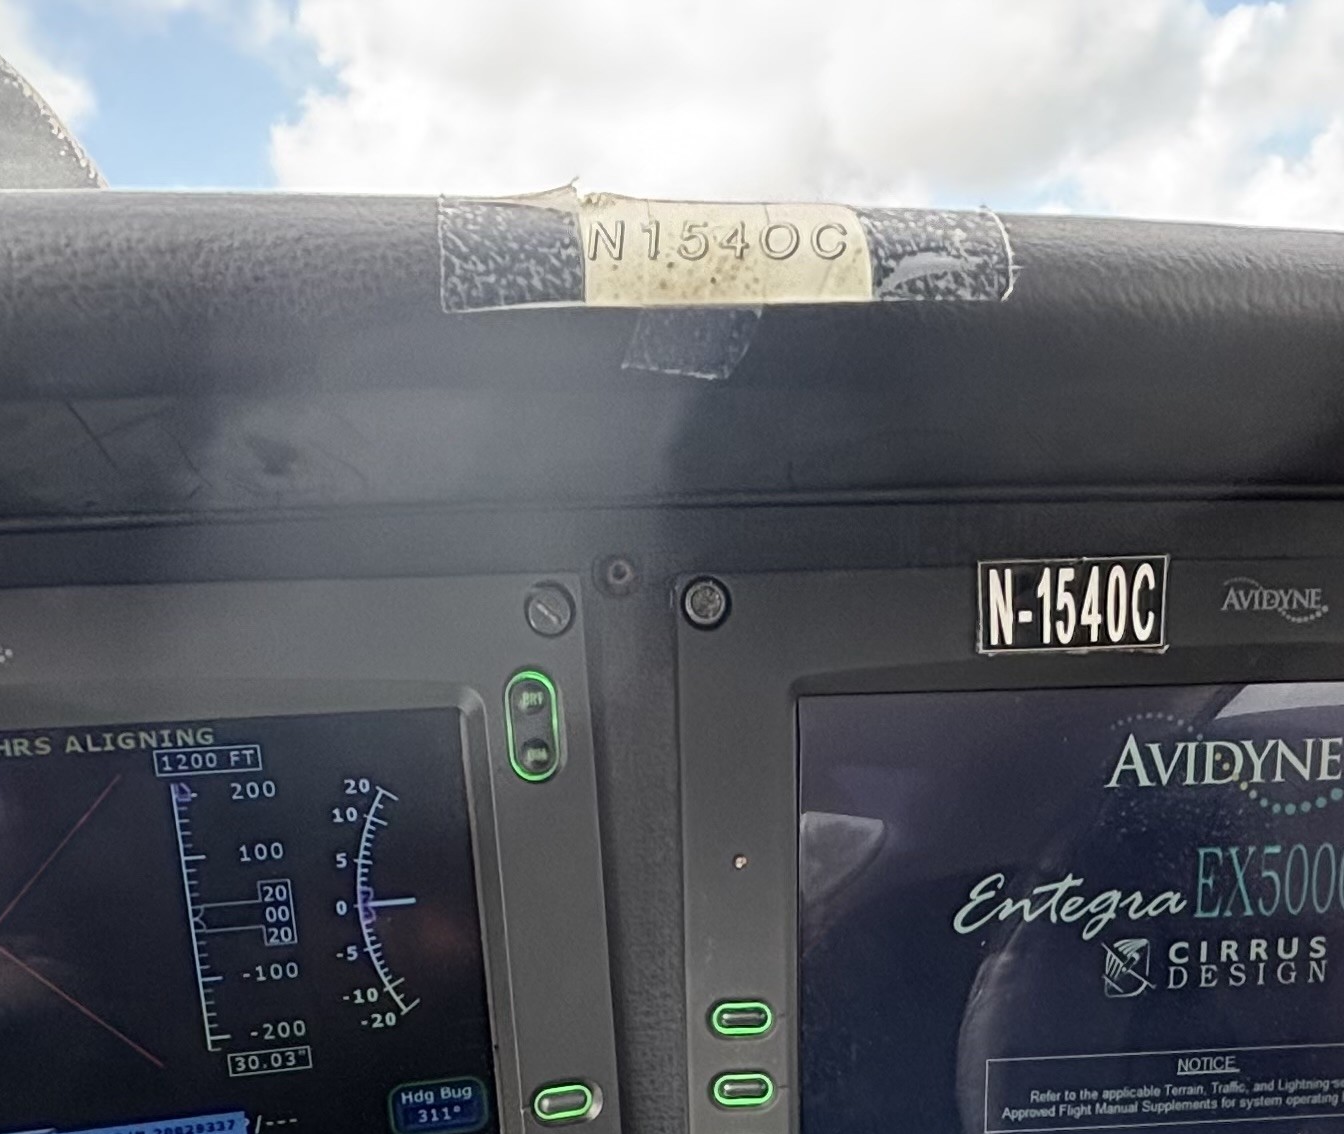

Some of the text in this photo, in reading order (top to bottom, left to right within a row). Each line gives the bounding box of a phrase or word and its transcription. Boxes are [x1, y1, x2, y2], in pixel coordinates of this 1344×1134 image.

[988, 563, 1155, 645] N-1540C
[1221, 587, 1322, 611] AVIDYNE
[65, 727, 215, 754] ALIGNING
[161, 750, 255, 771] 1200 FT
[1104, 734, 1344, 788] AVIDYNE
[231, 781, 276, 800] 200
[239, 842, 284, 862] 100
[953, 872, 1187, 940] Entegra
[1169, 936, 1328, 964] CIRRUS
[1166, 960, 1328, 991] DESIGN
[401, 1085, 473, 1106] Hdg Bug
[1002, 1098, 1217, 1122] Approved Flight Manual Supplements
